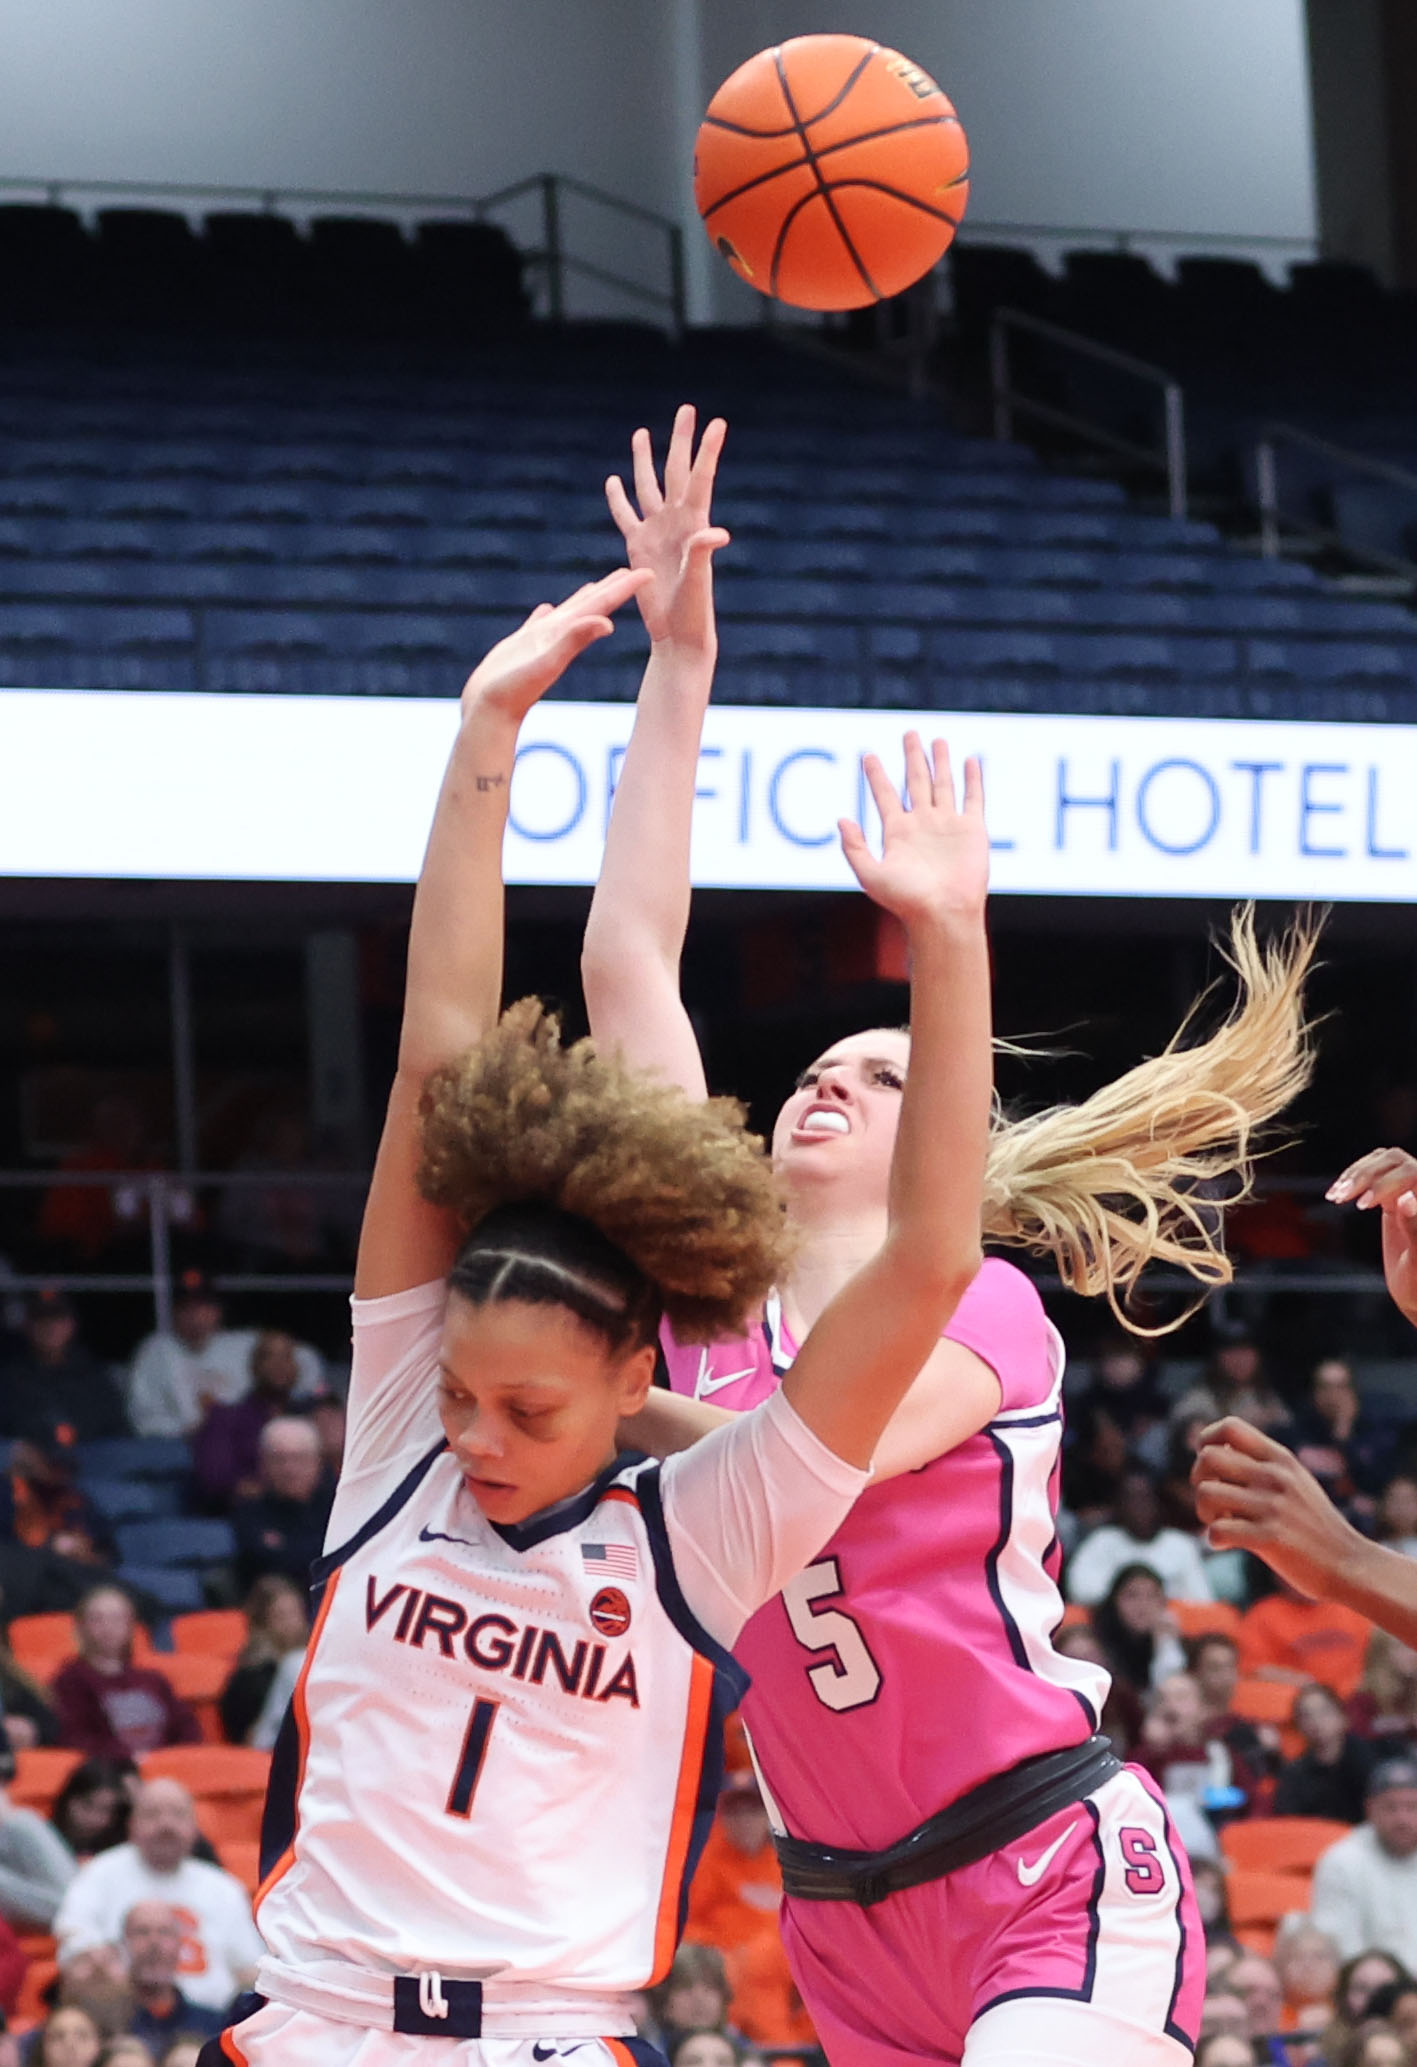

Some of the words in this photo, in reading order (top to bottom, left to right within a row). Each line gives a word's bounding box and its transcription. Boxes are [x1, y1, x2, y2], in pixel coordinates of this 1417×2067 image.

[508, 742, 1015, 852] OFICI
[1055, 757, 1409, 858] HOTEL
[365, 1574, 640, 1709] VIRGINIA
[782, 1555, 883, 1713] 5
[445, 1695, 501, 1820] 1
[1119, 1826, 1166, 1895] S
